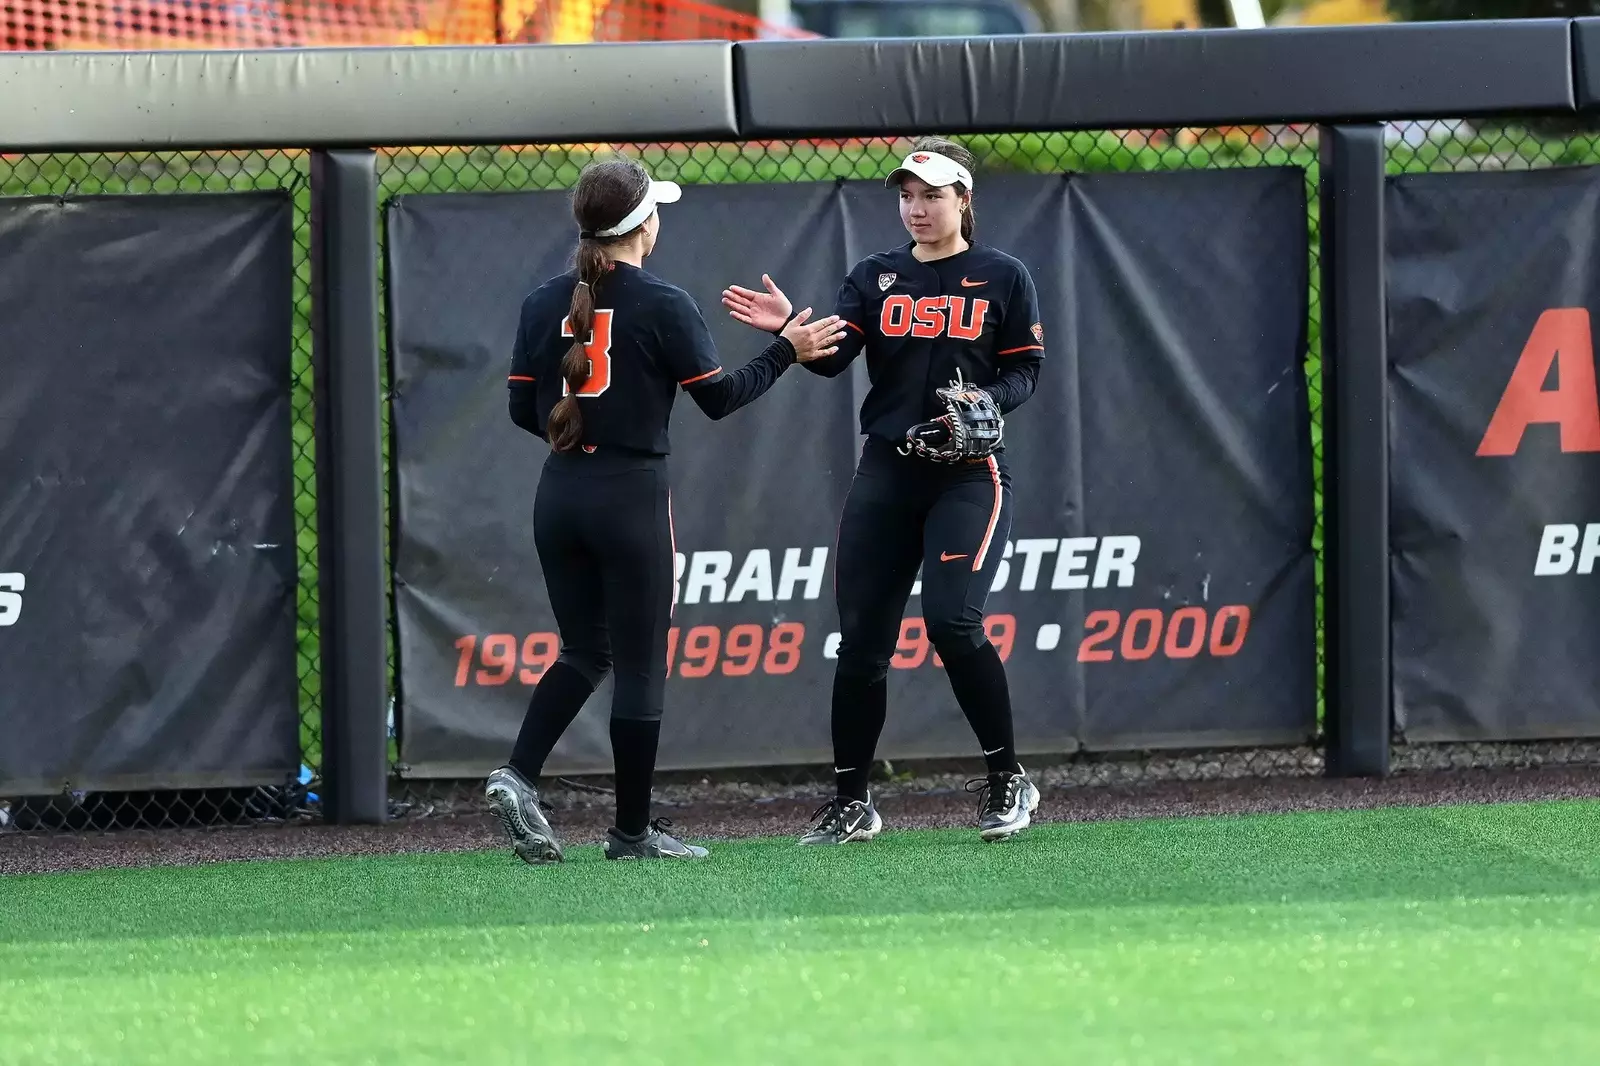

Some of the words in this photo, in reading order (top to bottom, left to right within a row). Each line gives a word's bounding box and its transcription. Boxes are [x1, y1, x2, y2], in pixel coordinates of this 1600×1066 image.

[561, 309, 614, 397] 3
[880, 294, 989, 341] OSU
[454, 632, 560, 687] 199
[1076, 604, 1251, 663] 2000
